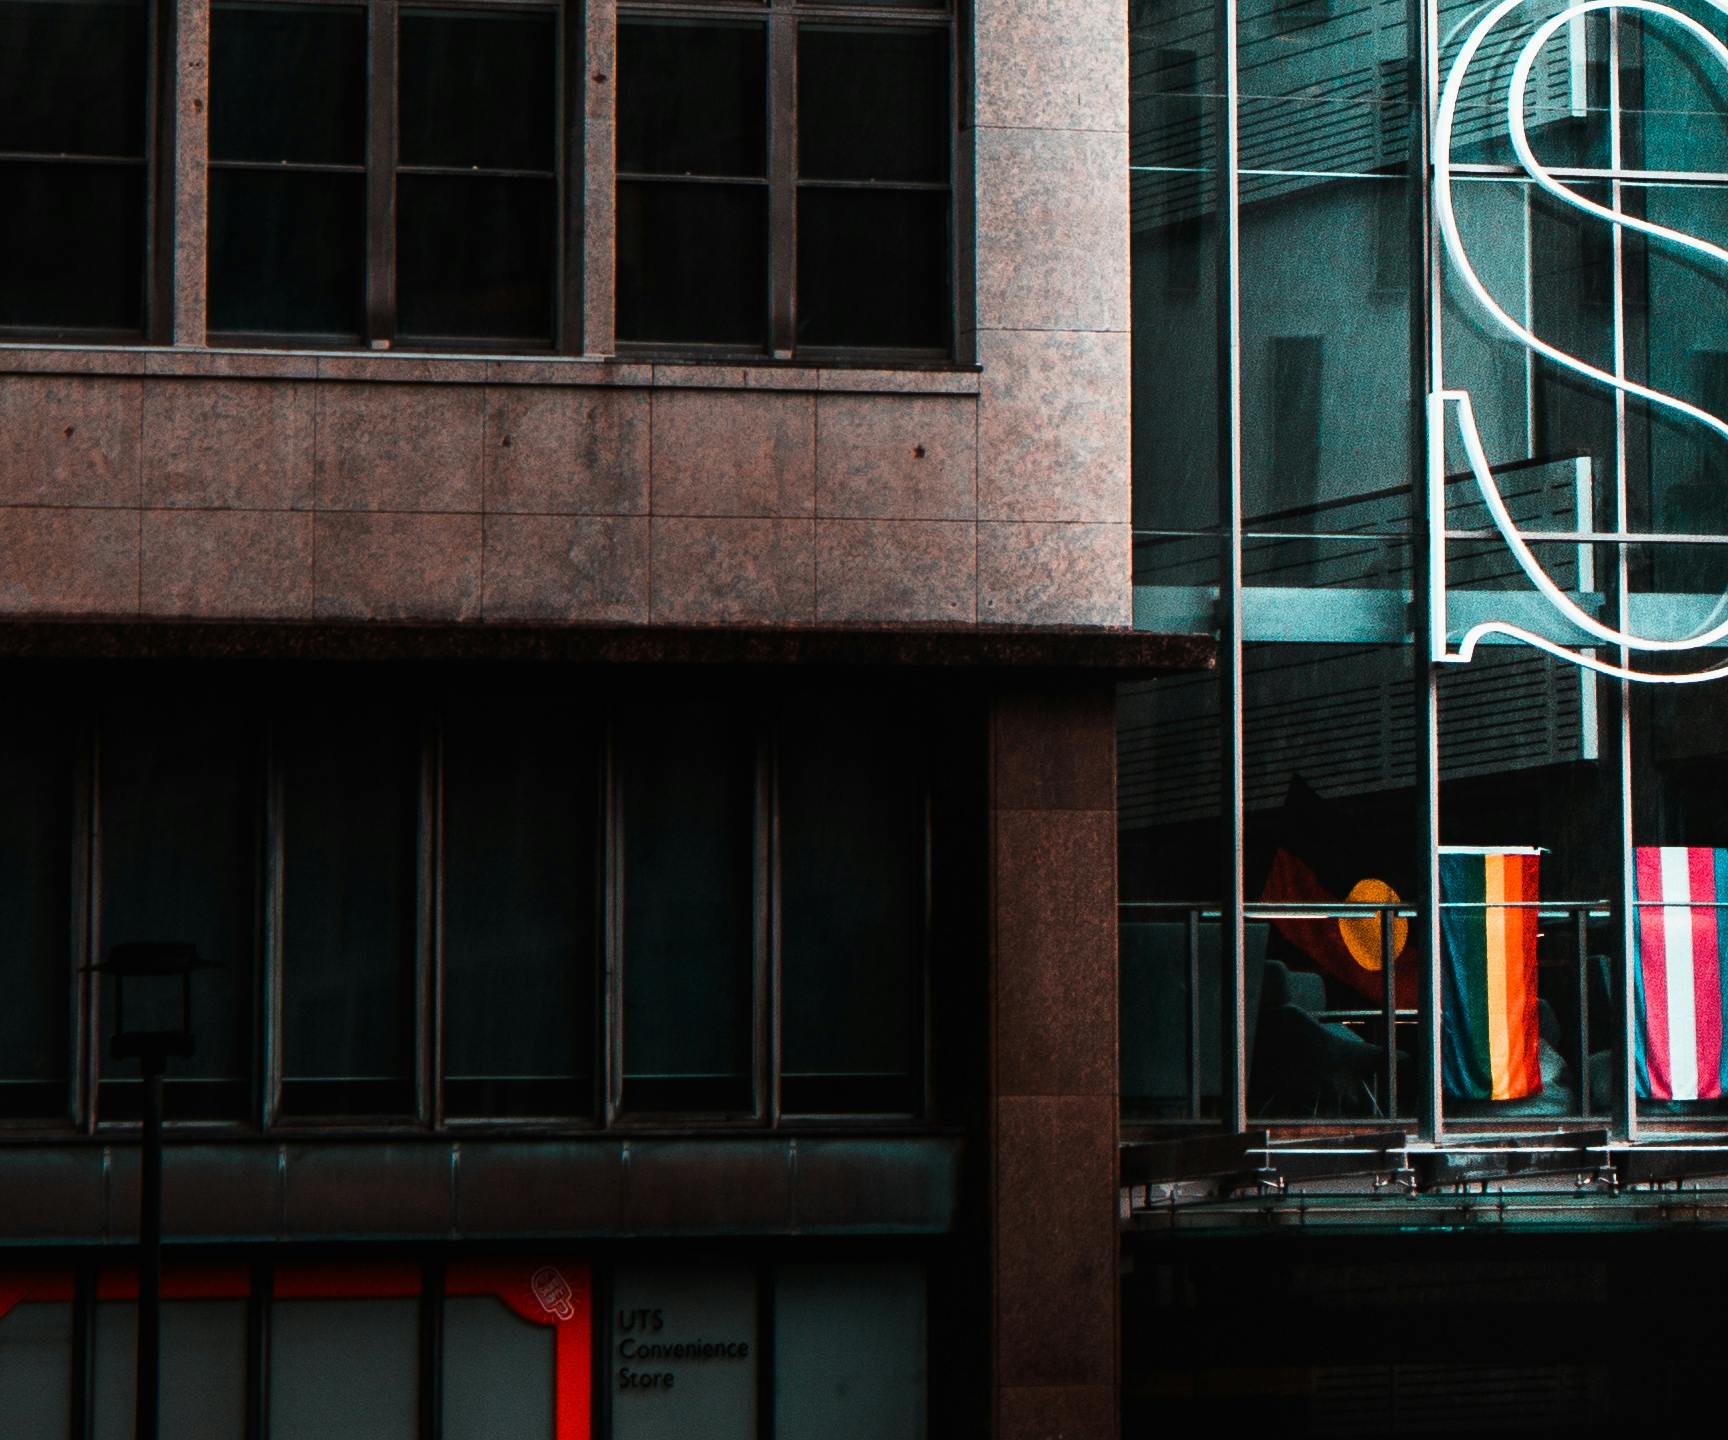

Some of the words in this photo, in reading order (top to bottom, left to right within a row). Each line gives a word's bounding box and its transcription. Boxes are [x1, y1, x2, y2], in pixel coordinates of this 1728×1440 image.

[618, 1308, 664, 1332] UTS
[619, 1338, 749, 1361] Convenience
[619, 1367, 675, 1390] Store
